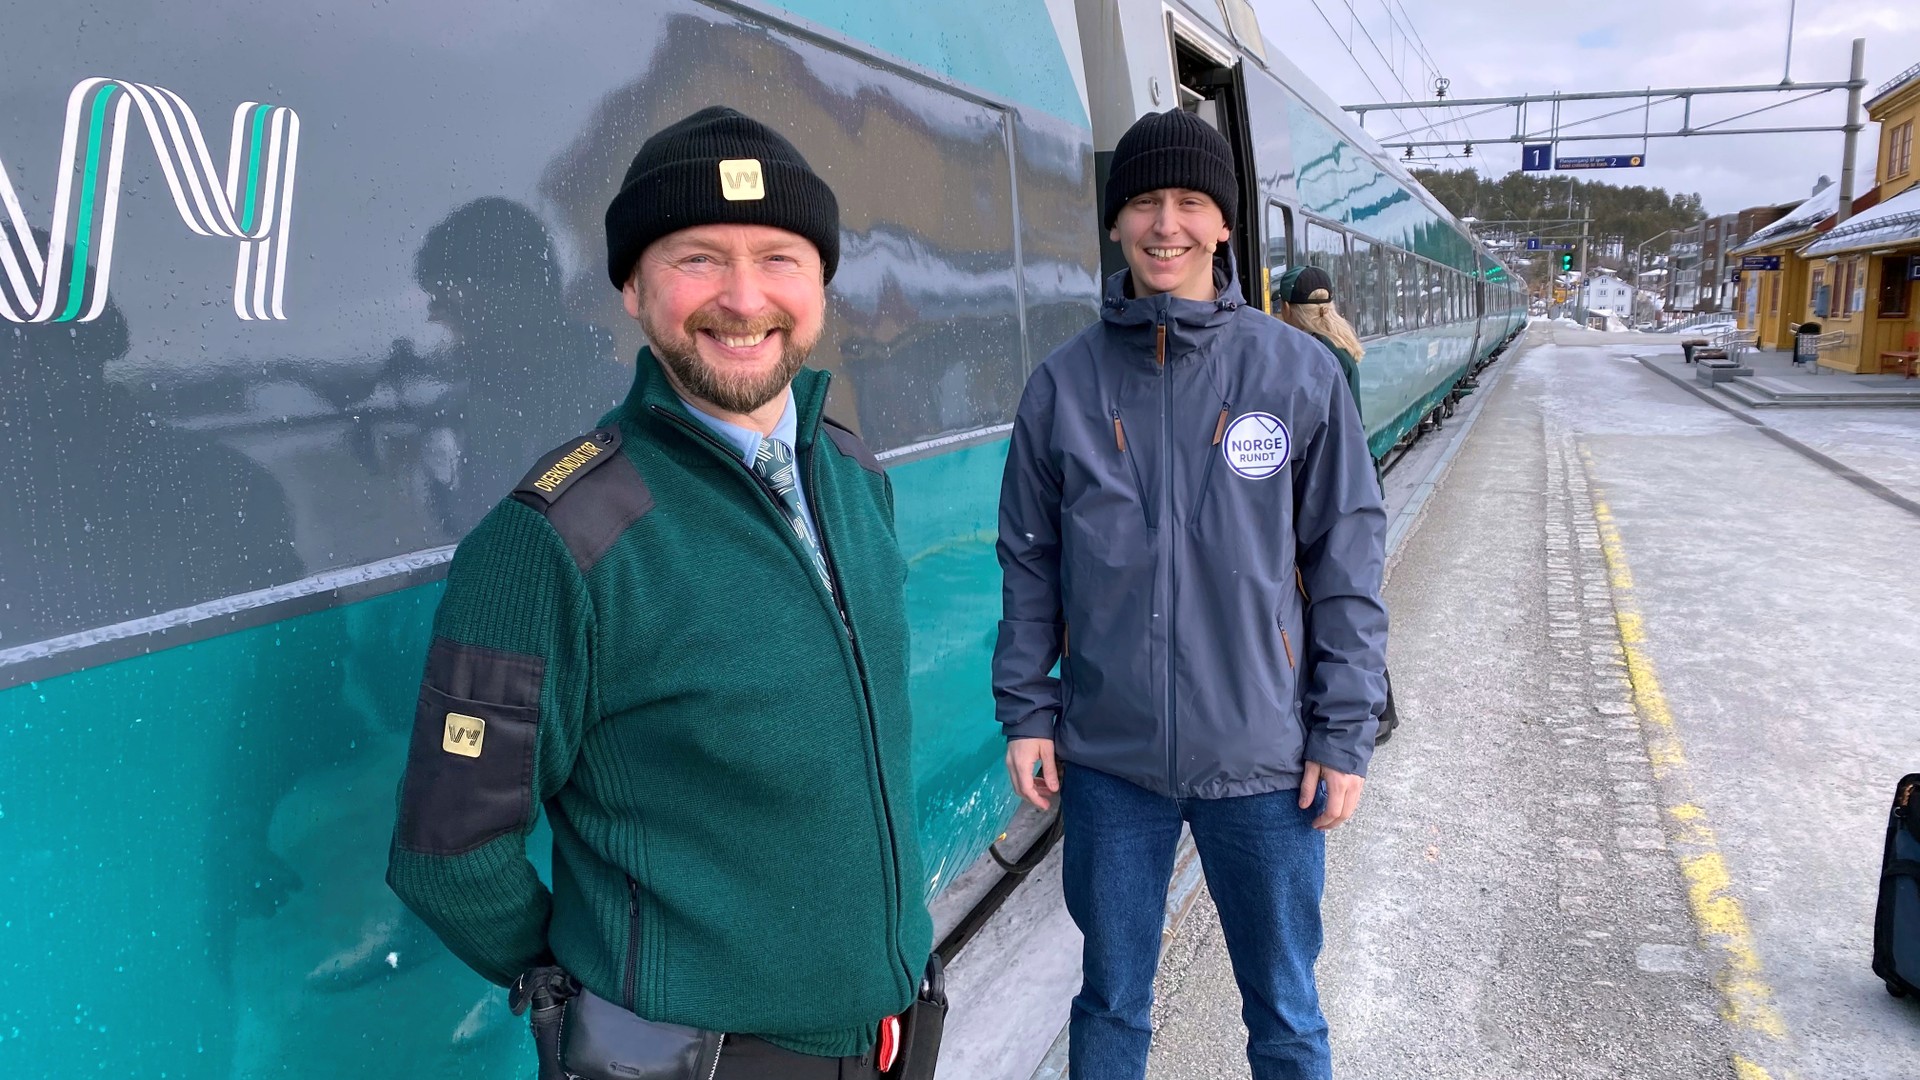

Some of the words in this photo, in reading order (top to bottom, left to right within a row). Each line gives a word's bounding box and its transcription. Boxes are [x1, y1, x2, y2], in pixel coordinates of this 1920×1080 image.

[1533, 149, 1540, 167] 1
[1611, 157, 1617, 167] 2
[1232, 437, 1282, 452] NORGE
[1240, 452, 1275, 463] RUNDT
